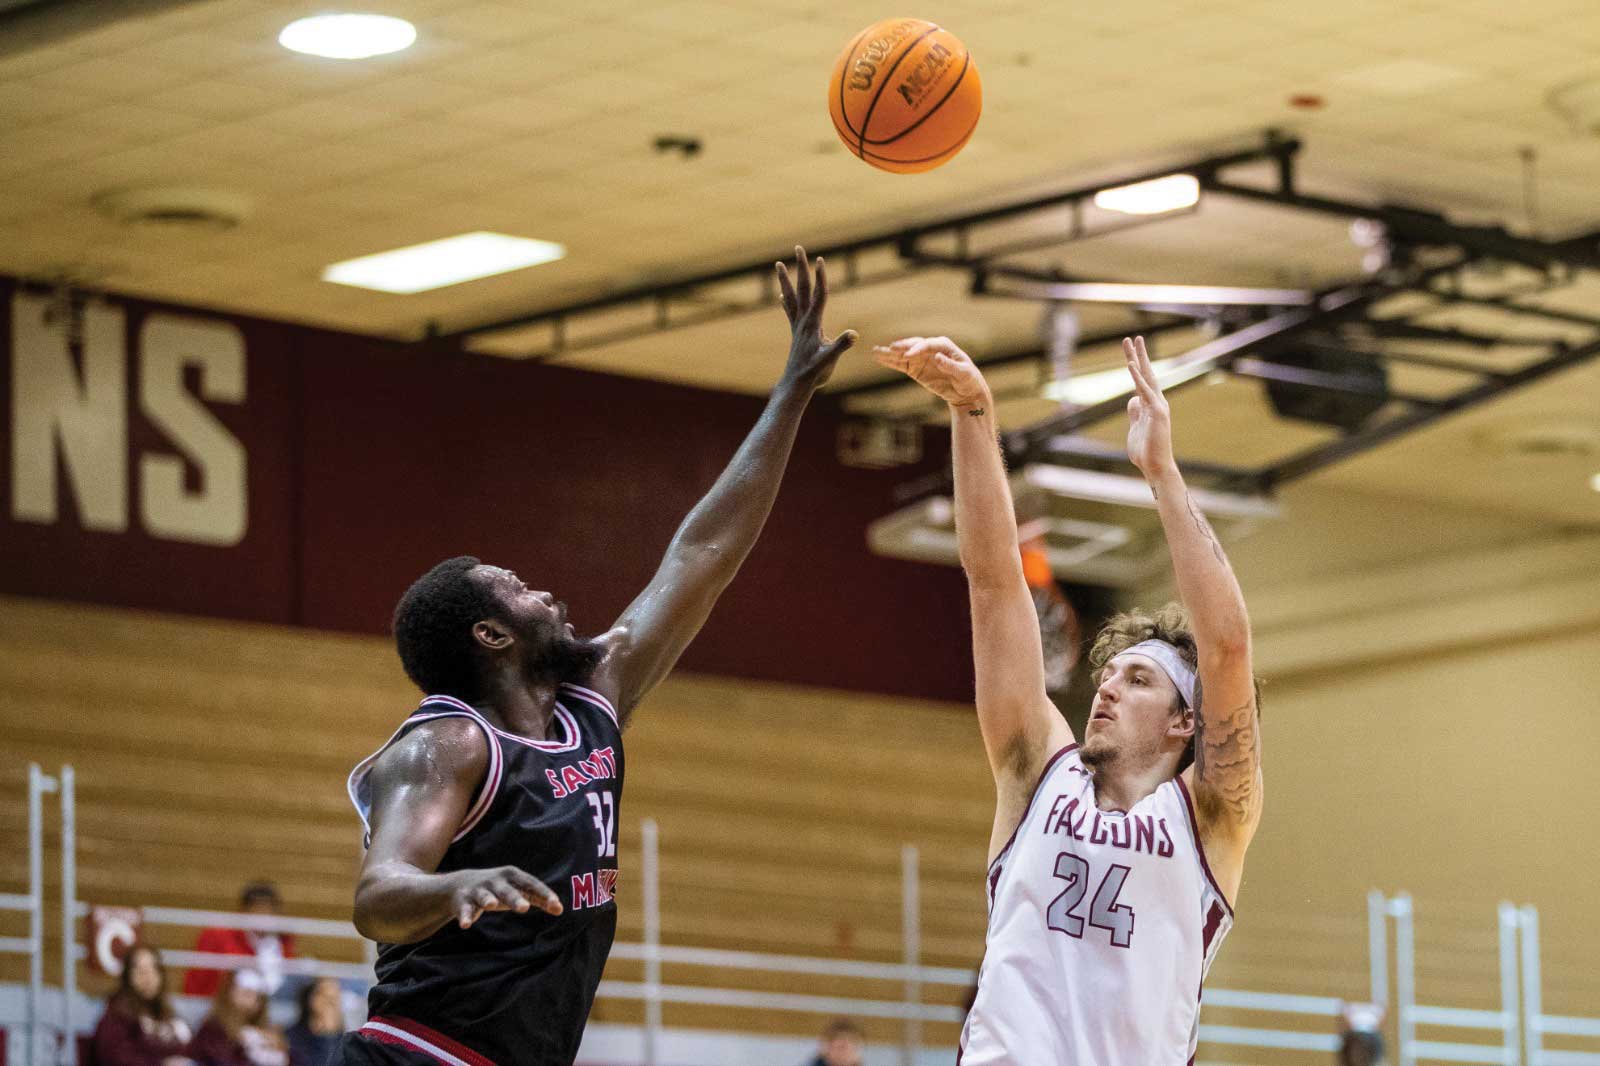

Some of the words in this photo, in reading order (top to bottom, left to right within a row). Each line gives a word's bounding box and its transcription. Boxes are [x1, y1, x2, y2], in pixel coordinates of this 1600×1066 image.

[897, 42, 952, 106] NCAA
[11, 294, 248, 547] NS
[586, 791, 615, 857] 32
[1043, 795, 1174, 858] FALCONS
[1047, 852, 1135, 948] 24
